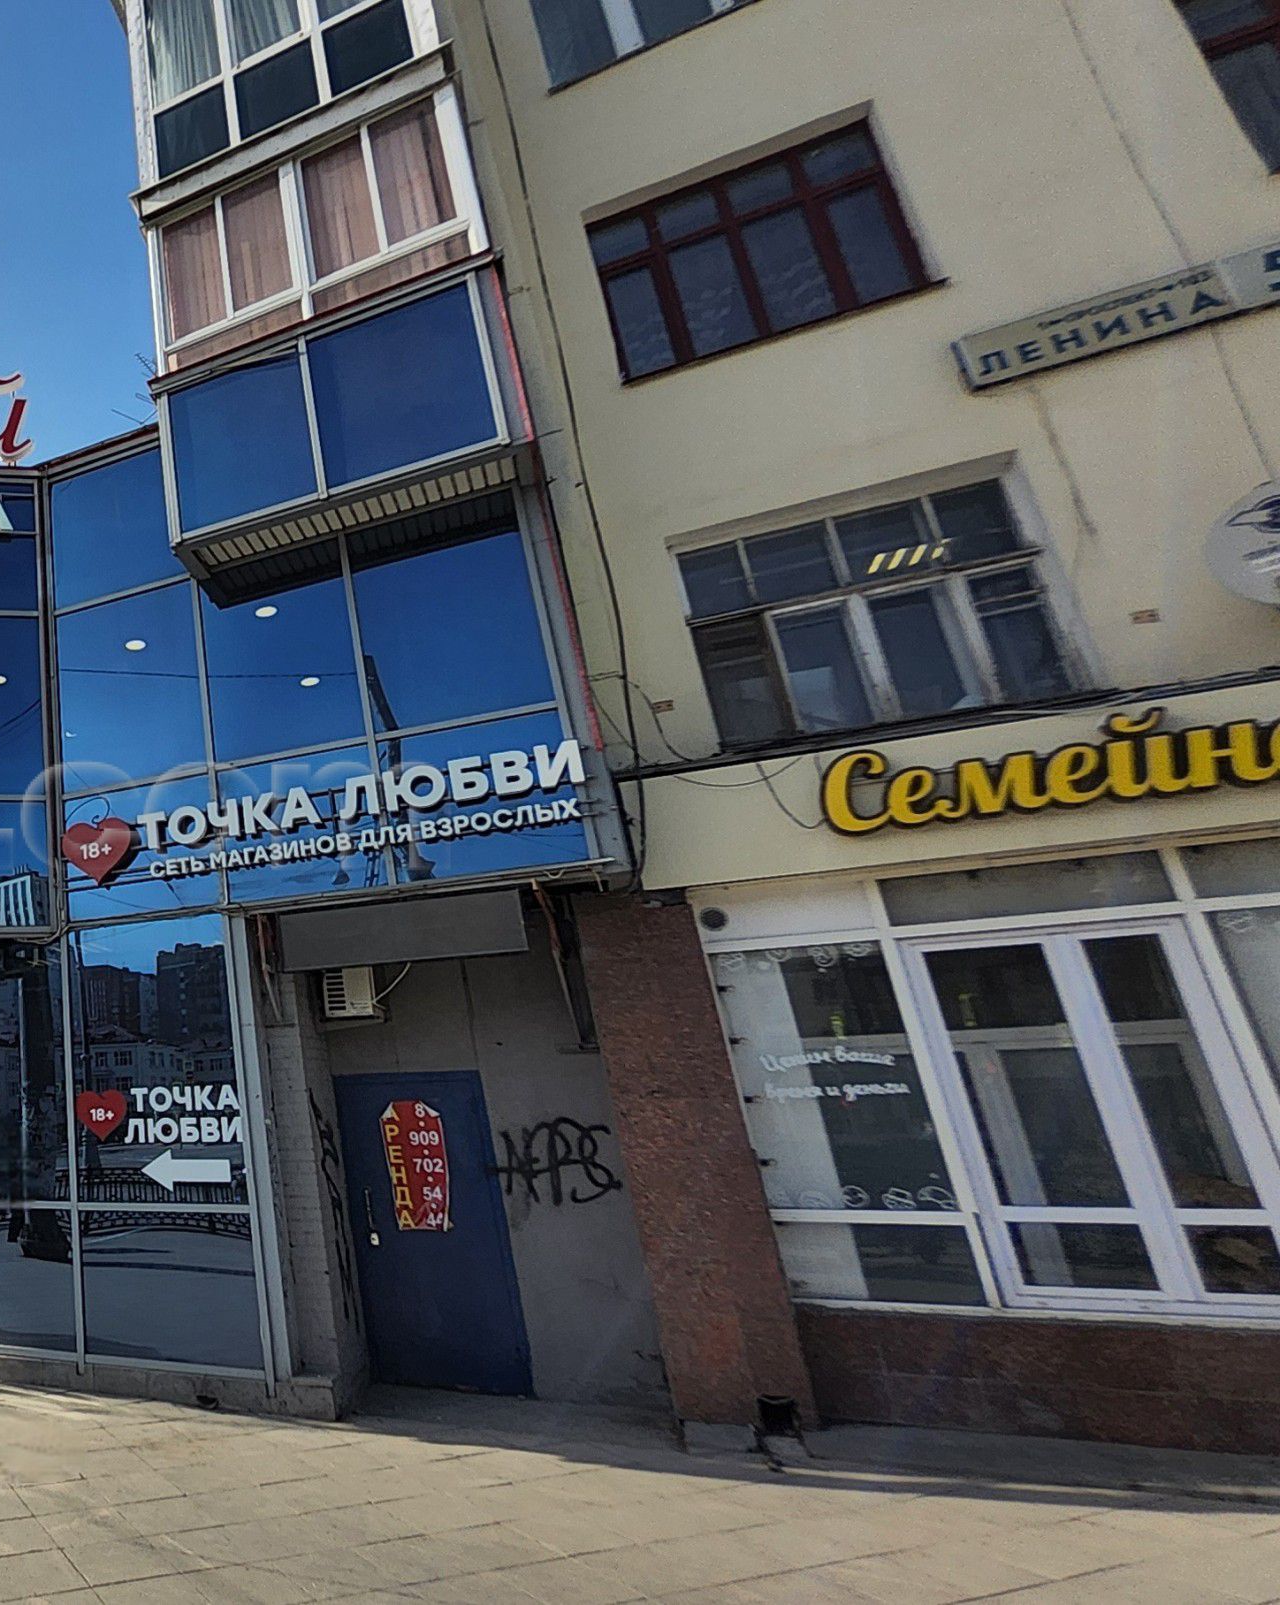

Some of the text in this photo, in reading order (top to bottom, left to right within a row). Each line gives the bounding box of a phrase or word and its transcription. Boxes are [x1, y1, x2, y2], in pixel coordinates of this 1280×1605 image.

[978, 290, 1228, 376] ЛЕНИНА
[823, 708, 1280, 834] Семейн
[136, 739, 586, 850] ТОЧКА ЛЮБВИ
[79, 842, 112, 861] 18+
[149, 798, 582, 879] СЕТЬ МАГАЗИНОВ ДЛЯ ВЗРОСЛЫХ
[130, 1084, 240, 1112] ТОЧКА
[414, 1102, 426, 1118] 8
[90, 1108, 115, 1122] 18+
[124, 1116, 244, 1144] ЛЮБВИ
[408, 1130, 440, 1146] 909
[382, 1103, 417, 1229] АРЕНДА
[412, 1157, 445, 1173] 702
[422, 1186, 443, 1201] 54
